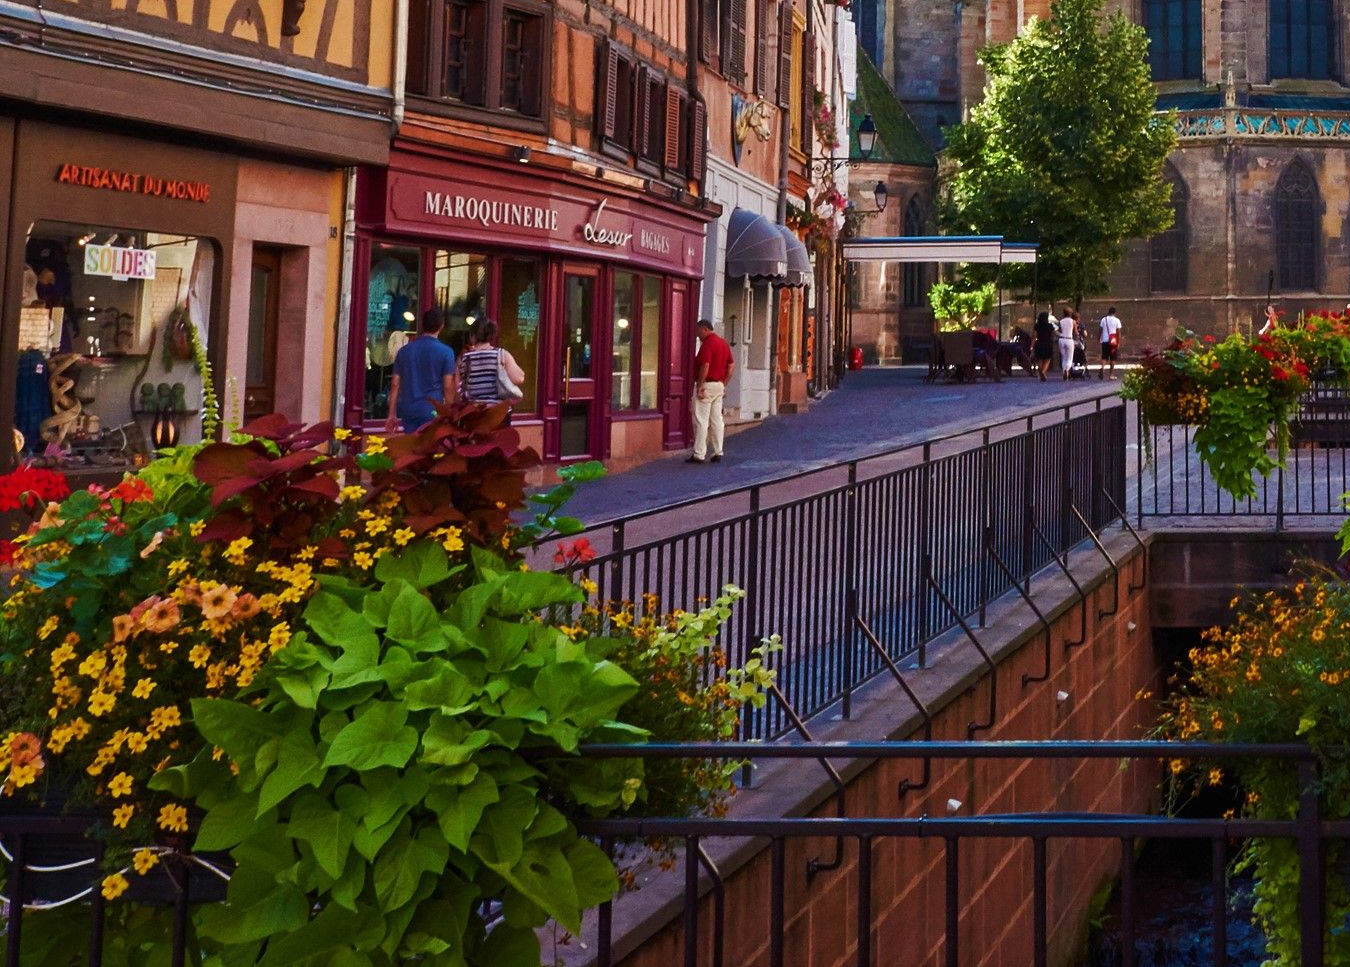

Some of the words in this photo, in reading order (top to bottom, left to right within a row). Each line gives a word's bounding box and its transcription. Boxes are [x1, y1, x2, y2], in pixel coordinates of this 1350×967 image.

[59, 163, 140, 193] ARTISANAT
[144, 175, 162, 196] DU
[166, 181, 210, 203] MONDE
[424, 191, 559, 231] MAROQUINERIE
[584, 197, 633, 247] Lesur
[640, 229, 670, 254] BAGAGES
[87, 246, 154, 277] SOLDES
